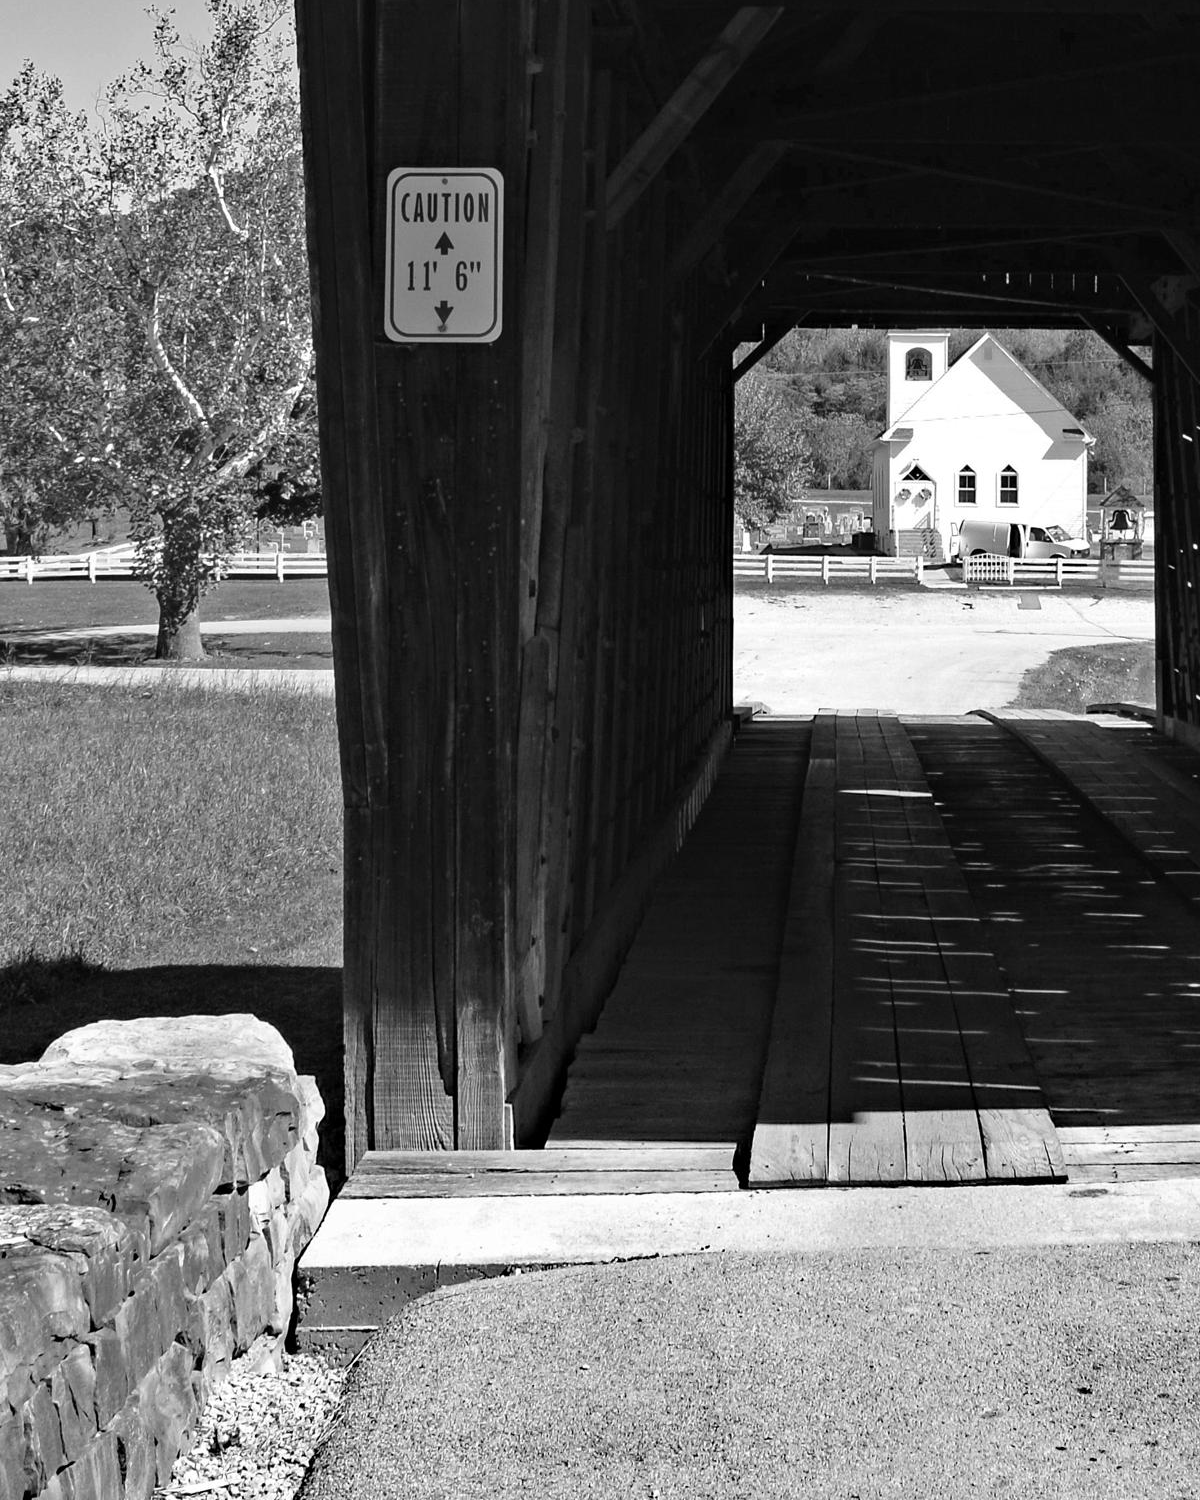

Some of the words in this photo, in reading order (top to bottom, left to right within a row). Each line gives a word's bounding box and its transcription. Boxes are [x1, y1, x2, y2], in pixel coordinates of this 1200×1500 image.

[401, 192, 489, 223] CAUTION
[407, 260, 438, 292] 11'
[455, 260, 481, 292] 6"
